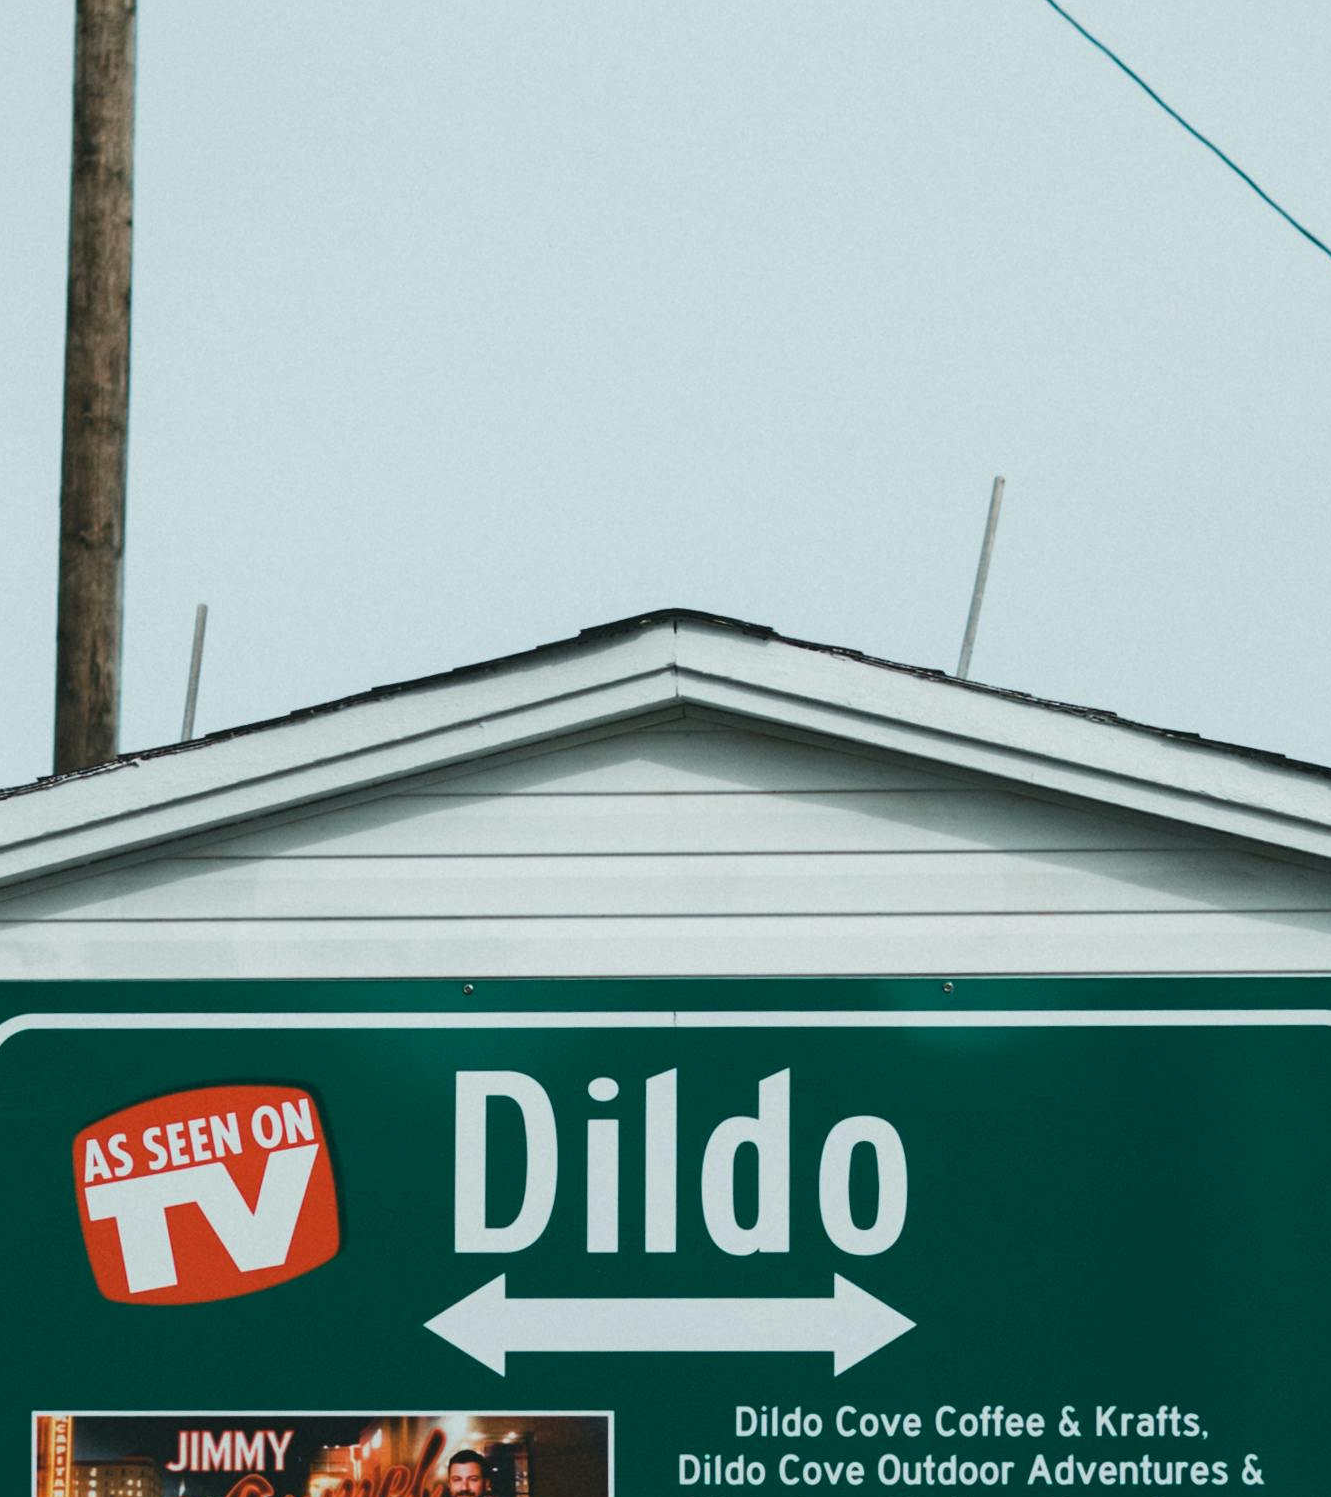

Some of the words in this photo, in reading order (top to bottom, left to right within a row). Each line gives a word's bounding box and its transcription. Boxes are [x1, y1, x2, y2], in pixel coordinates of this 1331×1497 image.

[84, 1133, 134, 1183] AS
[142, 1112, 243, 1171] SEEN
[251, 1098, 315, 1150] ON
[455, 1067, 908, 1256] Dildo
[84, 1143, 320, 1294] TV
[166, 1430, 294, 1472] JIMMY
[735, 1405, 823, 1438] Dildo
[835, 1405, 922, 1438] Cove
[935, 1405, 1045, 1438] Coffee
[1058, 1405, 1082, 1438] &
[1095, 1405, 1209, 1441] Krafts,
[678, 1453, 766, 1486] Dildo
[778, 1453, 865, 1486] Cove
[877, 1453, 1015, 1486] Outdoor
[1027, 1453, 1229, 1486] Adventures
[1241, 1453, 1265, 1486] &
